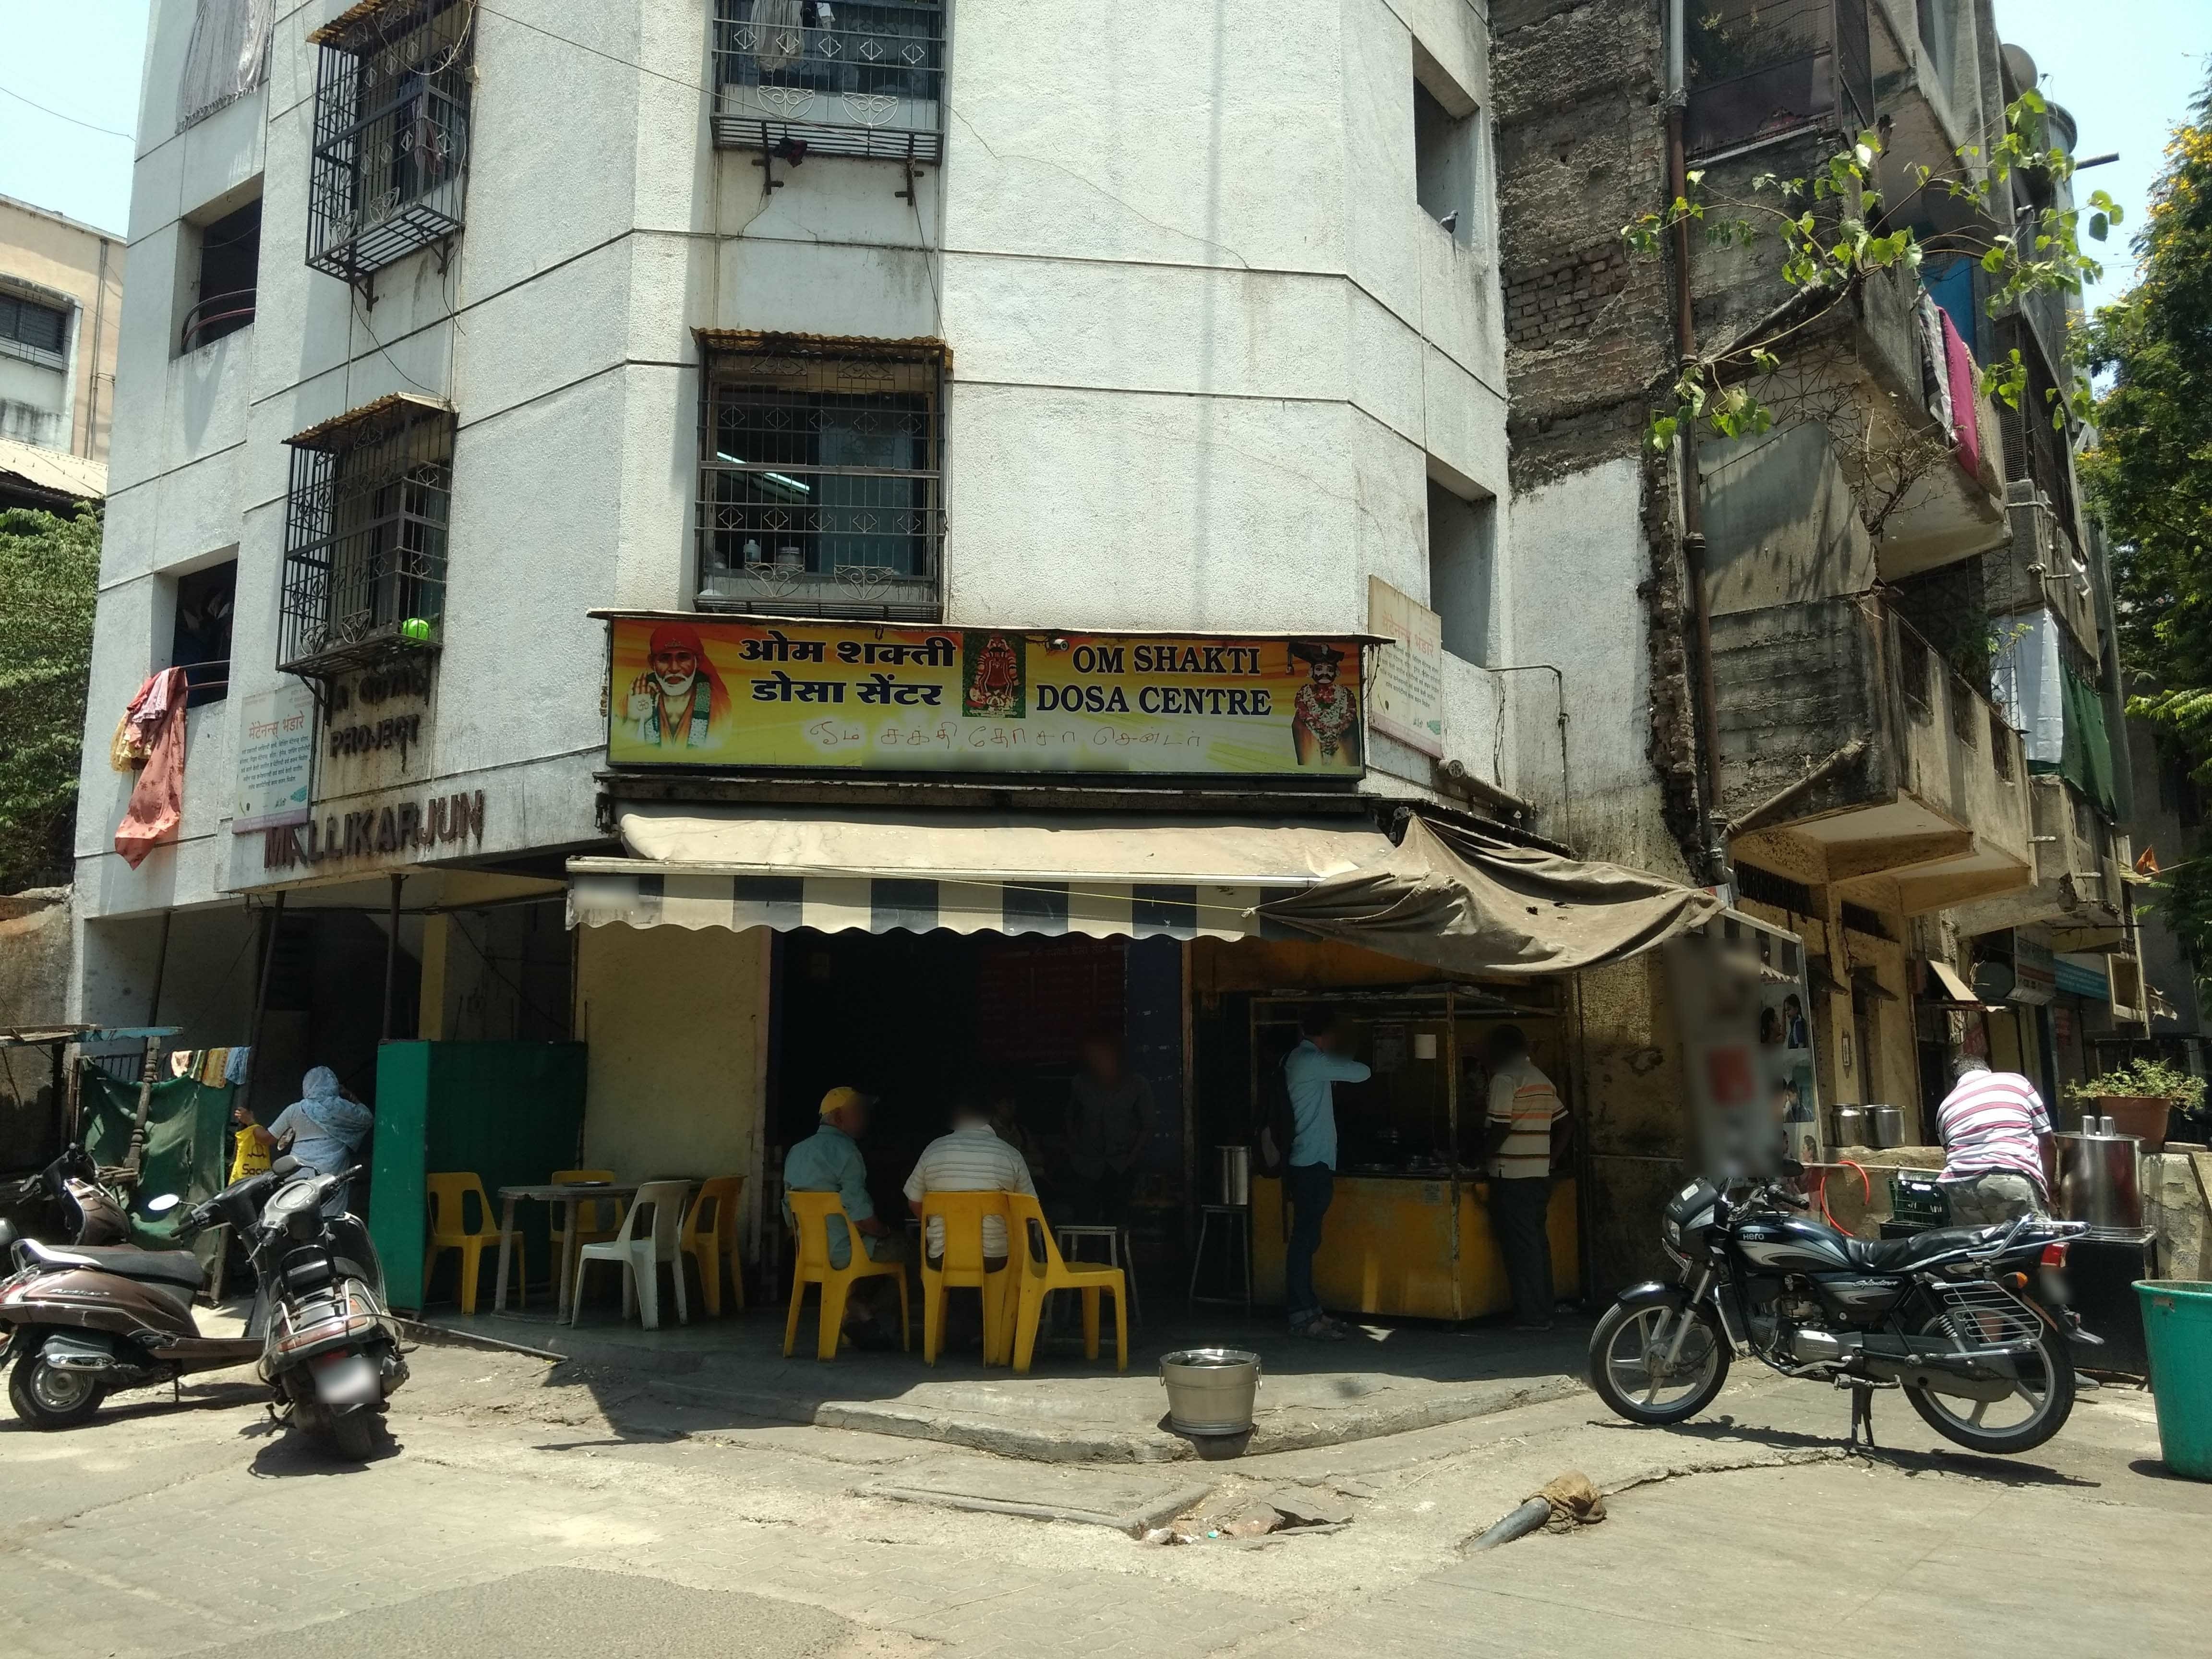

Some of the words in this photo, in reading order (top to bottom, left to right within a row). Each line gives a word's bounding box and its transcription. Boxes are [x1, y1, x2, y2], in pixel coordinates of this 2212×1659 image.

[738, 631, 826, 662] ओम
[837, 636, 957, 666] शक्ती
[1072, 646, 1125, 673] OM
[1134, 645, 1261, 674] SHAKTI
[751, 671, 847, 703] डोसा
[856, 673, 943, 705] सेंटर
[1036, 685, 1130, 713] DOSA
[1139, 686, 1272, 715] CENTRE
[330, 714, 421, 758] PROJECT
[810, 721, 859, 745] ஓம்
[881, 721, 957, 749] சக்தி
[263, 789, 485, 870] MALLIKARJUN
